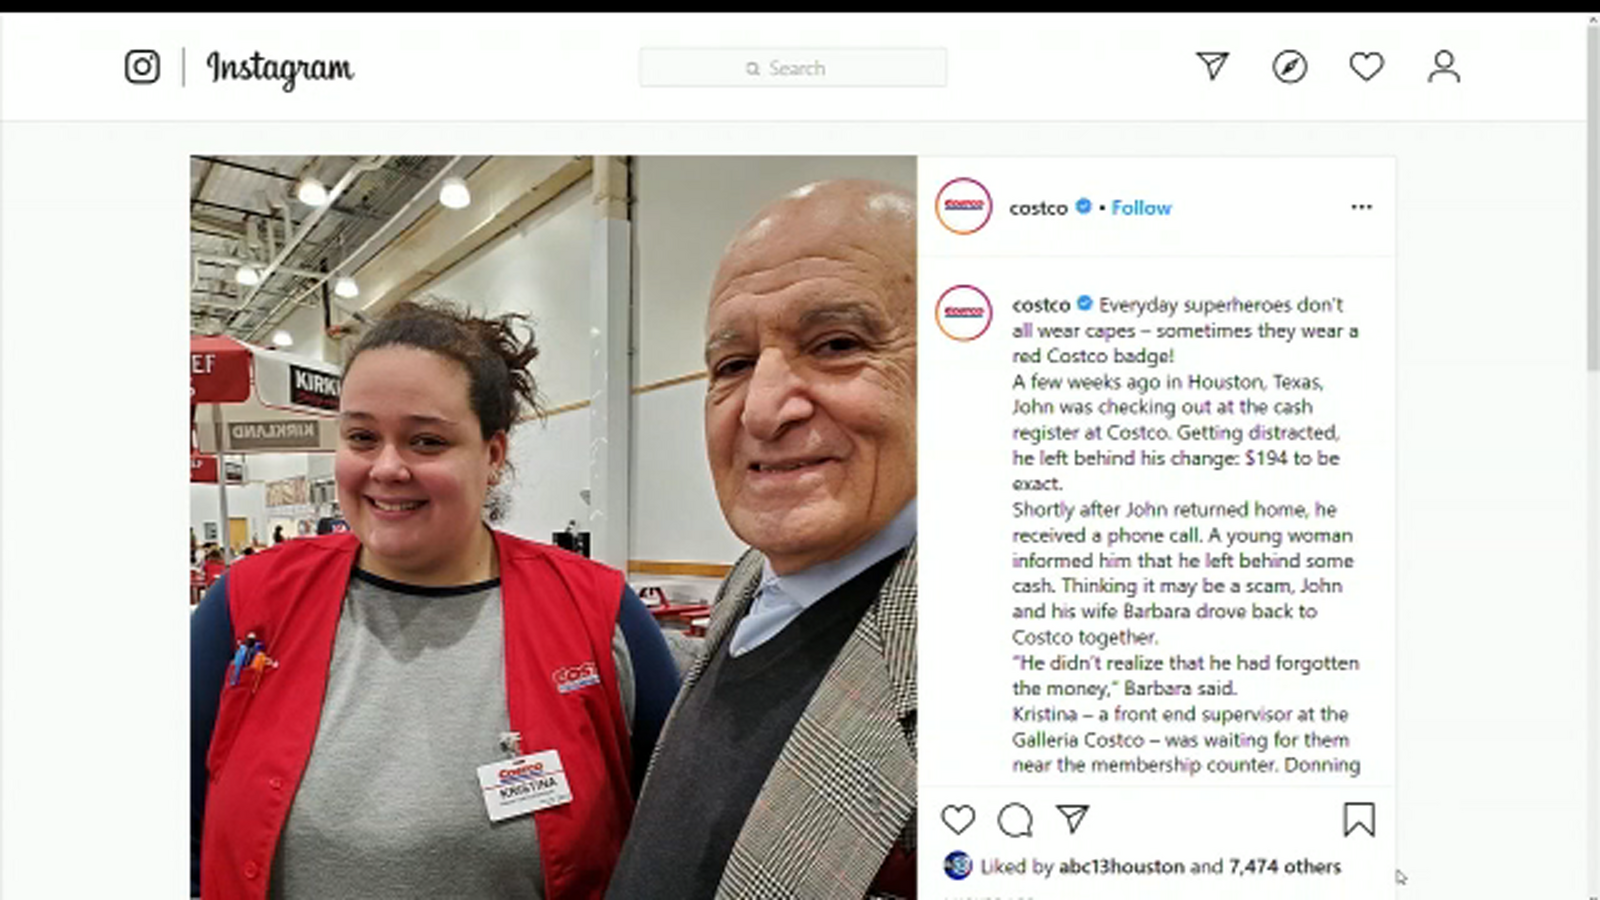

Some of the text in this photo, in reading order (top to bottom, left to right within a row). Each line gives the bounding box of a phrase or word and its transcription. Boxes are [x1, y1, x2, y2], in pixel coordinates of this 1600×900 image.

[206, 50, 355, 93] Instagram
[769, 60, 826, 76] Search
[1009, 200, 1069, 216] costco
[1111, 198, 1173, 216] Follow
[1012, 297, 1071, 313] costco
[1100, 296, 1178, 318] Everyday
[1184, 297, 1292, 316] superheroes
[1012, 322, 1033, 338] all
[1037, 327, 1080, 338] wear
[1085, 327, 1136, 342] capes
[1157, 322, 1252, 338] sometimes
[1258, 322, 1296, 343] they
[1301, 327, 1344, 338] wear
[1349, 327, 1359, 338] a
[1013, 347, 1174, 368] red Costco badge!
[1012, 372, 1323, 395] A few weeks ago in Houston, Texas,
[1013, 398, 1313, 420] John was checking out at the cash
[1013, 424, 1339, 446] register at Costco. Getting distracted,
[1013, 449, 1340, 471] he left behind his change: $194 to be
[1012, 478, 1063, 491] exact.
[1013, 500, 1337, 522] Shortly after John returned home, he
[1013, 526, 1353, 548] received a phone call. A young woman
[1013, 552, 1354, 568] informed him that he left behind some
[1012, 577, 1343, 598] cash. Thinking it may be a scam, John
[1012, 602, 1318, 619] and his wife Barbara drove back to
[1012, 629, 1158, 650] Costco together.
[1107, 654, 1164, 671] realize
[1169, 655, 1204, 671] that
[1210, 655, 1231, 670] he
[1237, 654, 1270, 670] had
[1276, 655, 1359, 676] forgotten
[1013, 680, 1041, 695] the
[1125, 679, 1192, 696] Barbara
[1197, 680, 1237, 696] said.
[1013, 707, 1078, 722] Kristina
[1099, 710, 1108, 722] a
[1114, 705, 1157, 723] front
[1162, 705, 1196, 722] end
[1202, 710, 1293, 726] supervisor
[1297, 708, 1315, 722] at
[1320, 705, 1348, 722] the
[1012, 730, 1079, 748] Galleria
[1084, 732, 1145, 748] Costco
[1165, 735, 1198, 748] was
[1204, 732, 1268, 753] waiting
[1274, 730, 1298, 748] for
[1304, 731, 1349, 748] them
[1013, 756, 1360, 778] near the membership counter. Donning
[499, 778, 557, 798] KRISTINA
[980, 858, 1026, 876] Liked
[1033, 858, 1055, 880] by
[1059, 858, 1185, 876] abc13houston
[1190, 858, 1223, 876] and
[1230, 858, 1279, 878] 7,474
[1284, 858, 1342, 876] others
